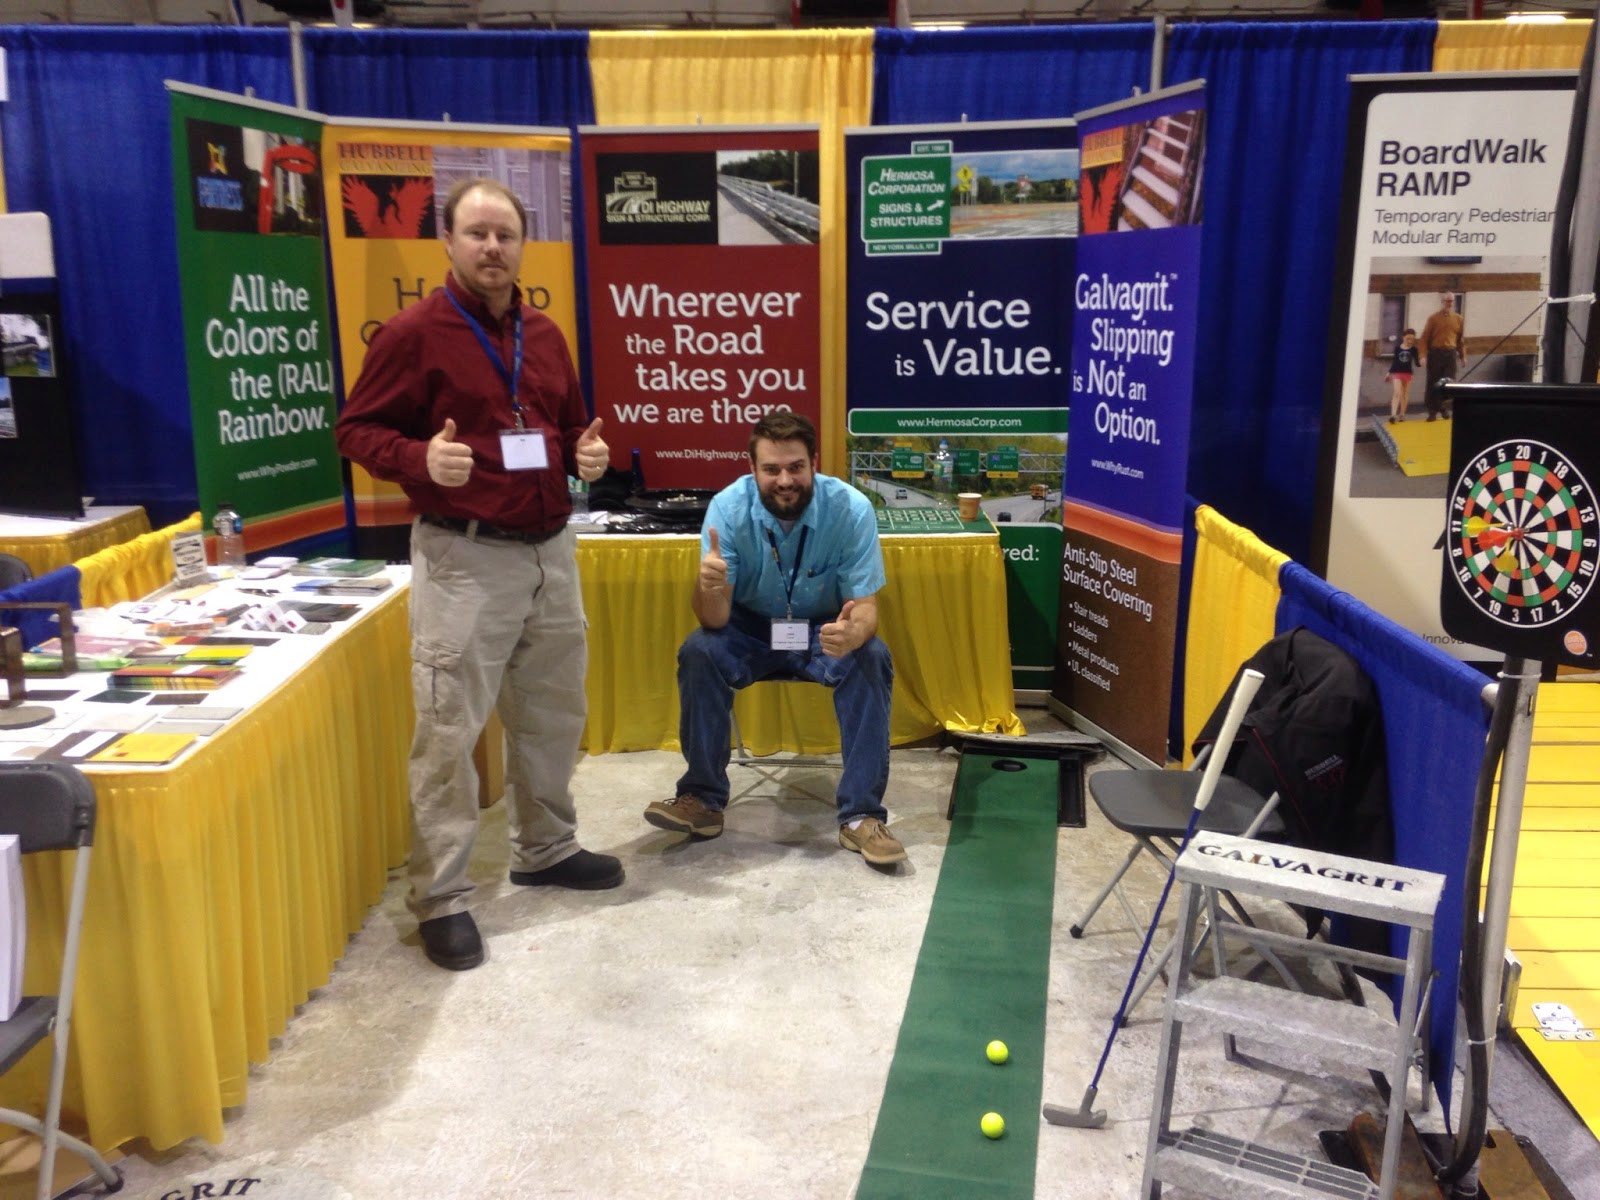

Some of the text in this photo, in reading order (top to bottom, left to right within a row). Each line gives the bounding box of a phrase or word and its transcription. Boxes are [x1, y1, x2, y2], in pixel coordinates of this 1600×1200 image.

[1379, 138, 1548, 166] BoardWalk
[880, 168, 935, 182] HERMOSA
[1376, 171, 1472, 197] RAMP
[867, 181, 946, 196] CORPORATION
[655, 200, 711, 214] HIGHWAY
[879, 202, 923, 214] SIGNS &
[870, 215, 943, 228] STRUCTURES
[1375, 208, 1464, 226] Temporary
[1372, 229, 1497, 247] Modular Ramp
[229, 273, 310, 313] All the
[608, 283, 802, 318] Wherever
[866, 290, 1031, 331] Service
[206, 317, 290, 359] Colors
[295, 320, 319, 352] of
[625, 324, 764, 355] the Road
[1090, 317, 1175, 367] Slipping
[894, 337, 1063, 377] is Value.
[230, 359, 335, 401] the (RAL)
[636, 360, 807, 399] takes you
[1073, 358, 1147, 401] is Not an
[613, 403, 660, 424] we
[667, 407, 704, 424] are
[218, 403, 330, 445] Rainbow.
[897, 417, 1022, 429] www.HermosaCorp.com
[1095, 401, 1161, 445] Option.
[1497, 449, 1506, 462] 5
[1516, 445, 1531, 460] 20
[1540, 451, 1547, 464] 1
[1475, 458, 1490, 475] 12
[1553, 461, 1569, 479] 18
[1463, 476, 1474, 489] 9
[1570, 483, 1583, 496] 4
[1454, 496, 1466, 512] 14
[1580, 506, 1595, 523] 13
[1452, 520, 1462, 533] 11
[1452, 547, 1462, 557] 8
[1063, 542, 1137, 587] Anti-Slip Steel
[1579, 560, 1595, 577] 10
[1458, 566, 1471, 583] 16
[1063, 563, 1154, 622] Surface Covering
[1473, 587, 1483, 599] 7
[1567, 582, 1583, 599] 15
[1073, 601, 1109, 629] Stair treads
[1489, 600, 1502, 616] 19
[1512, 608, 1520, 623] 3
[1530, 607, 1543, 622] 17
[1552, 599, 1563, 614] 2
[1072, 621, 1098, 644] Ladders
[1072, 641, 1120, 676] Metal products
[1071, 660, 1111, 691] UL classified
[1197, 845, 1413, 892] GALVAGRIT
